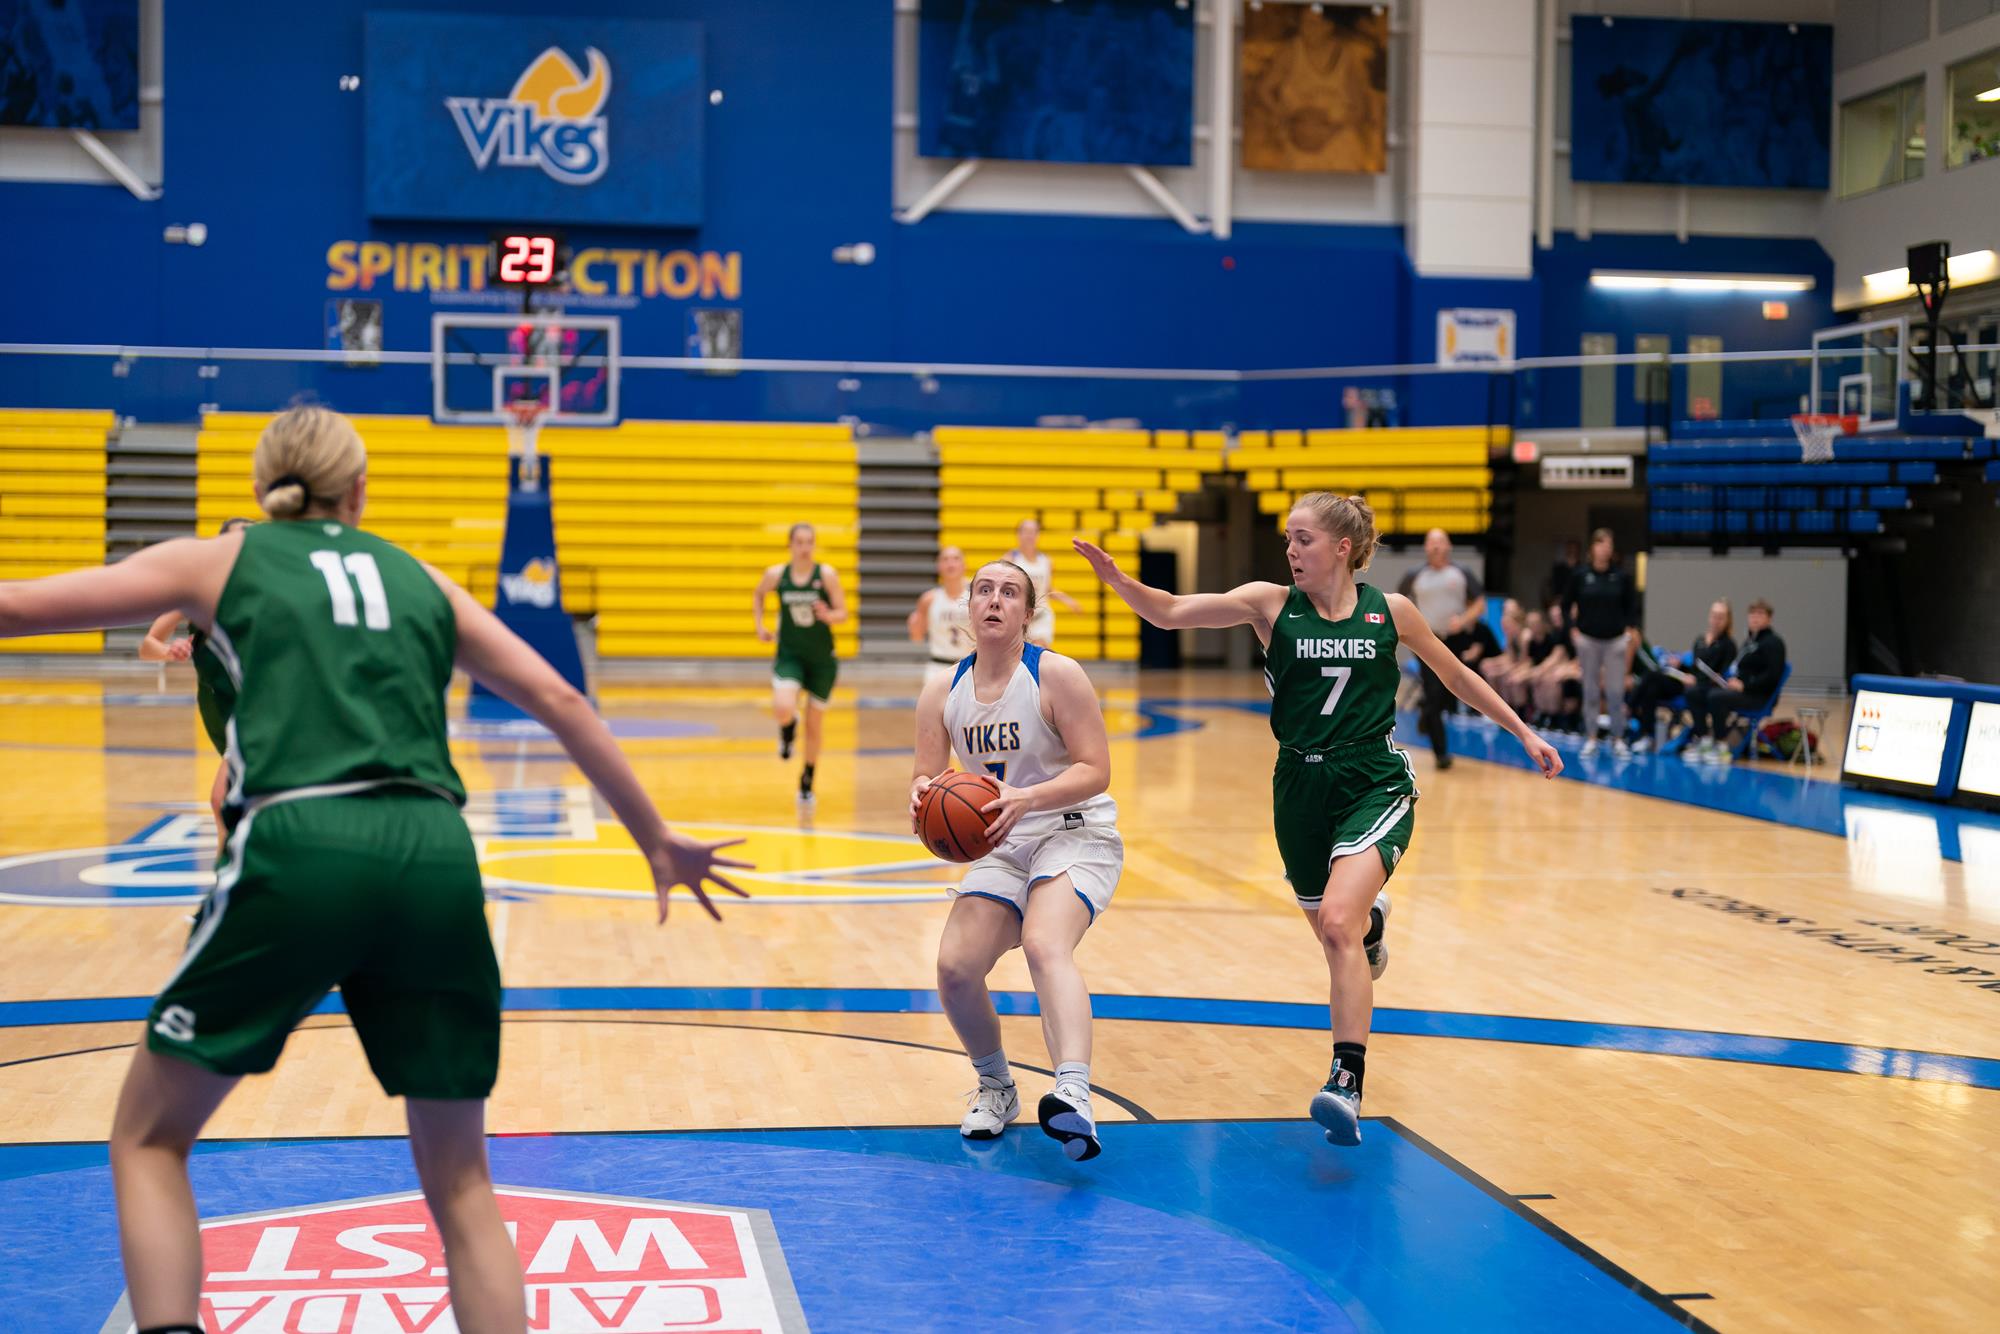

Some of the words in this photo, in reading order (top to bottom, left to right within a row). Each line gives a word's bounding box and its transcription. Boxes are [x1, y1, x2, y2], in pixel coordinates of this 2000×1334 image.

[444, 96, 608, 185] Vikes
[326, 240, 492, 292] SPIRIT
[557, 246, 743, 298] CTION
[501, 236, 554, 282] 23
[309, 550, 391, 630] 11
[1296, 638, 1377, 659] HUSKIES
[1320, 666, 1352, 715] 7
[963, 722, 1020, 755] VIKES
[206, 1217, 710, 1281] WST
